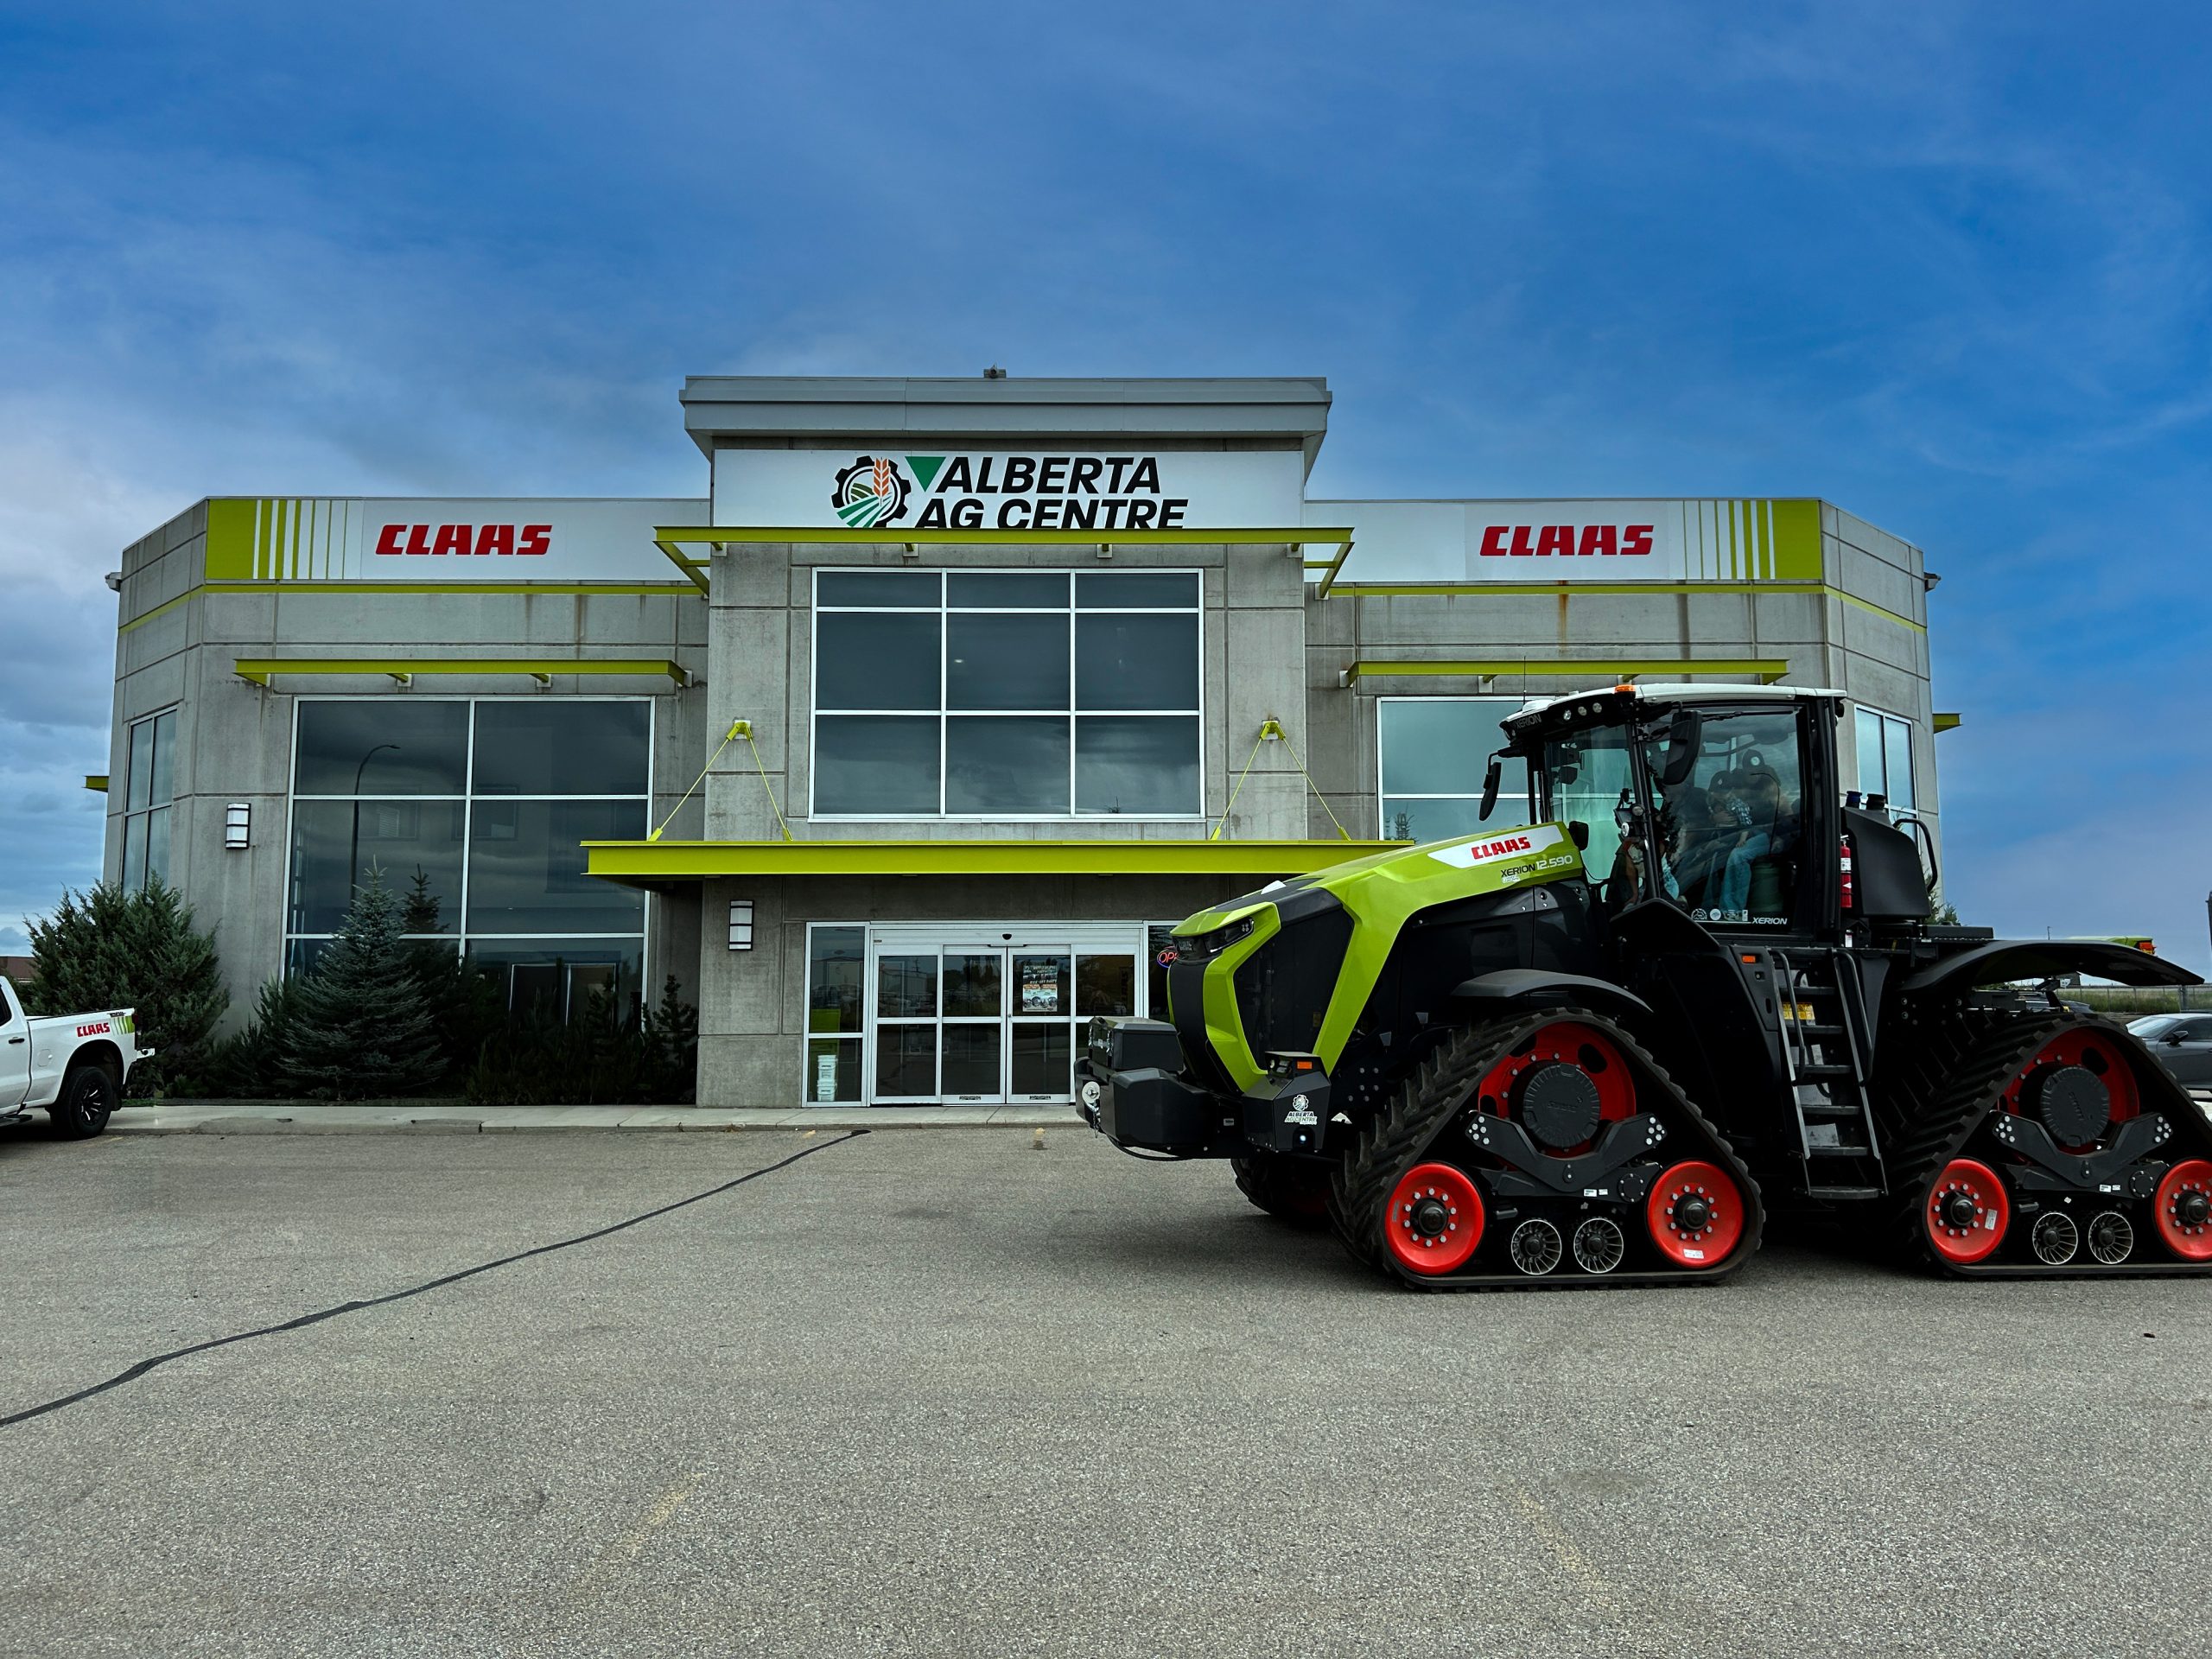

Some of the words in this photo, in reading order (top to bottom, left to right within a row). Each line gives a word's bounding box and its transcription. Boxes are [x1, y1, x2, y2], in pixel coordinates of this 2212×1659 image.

[935, 456, 1161, 494] ALBERTA
[914, 498, 985, 529] AG
[997, 498, 1189, 529] CENTRE
[375, 524, 553, 556] CLAAS
[1479, 524, 1654, 556] CLAAS
[1514, 714, 1542, 728] XERION
[1471, 836, 1531, 860] CLAAS
[1500, 863, 1536, 878] XERION
[1535, 855, 1573, 871] 12.590
[1751, 917, 1788, 925] XERION
[1159, 951, 1179, 963] OP
[76, 1022, 111, 1038] CLAAS
